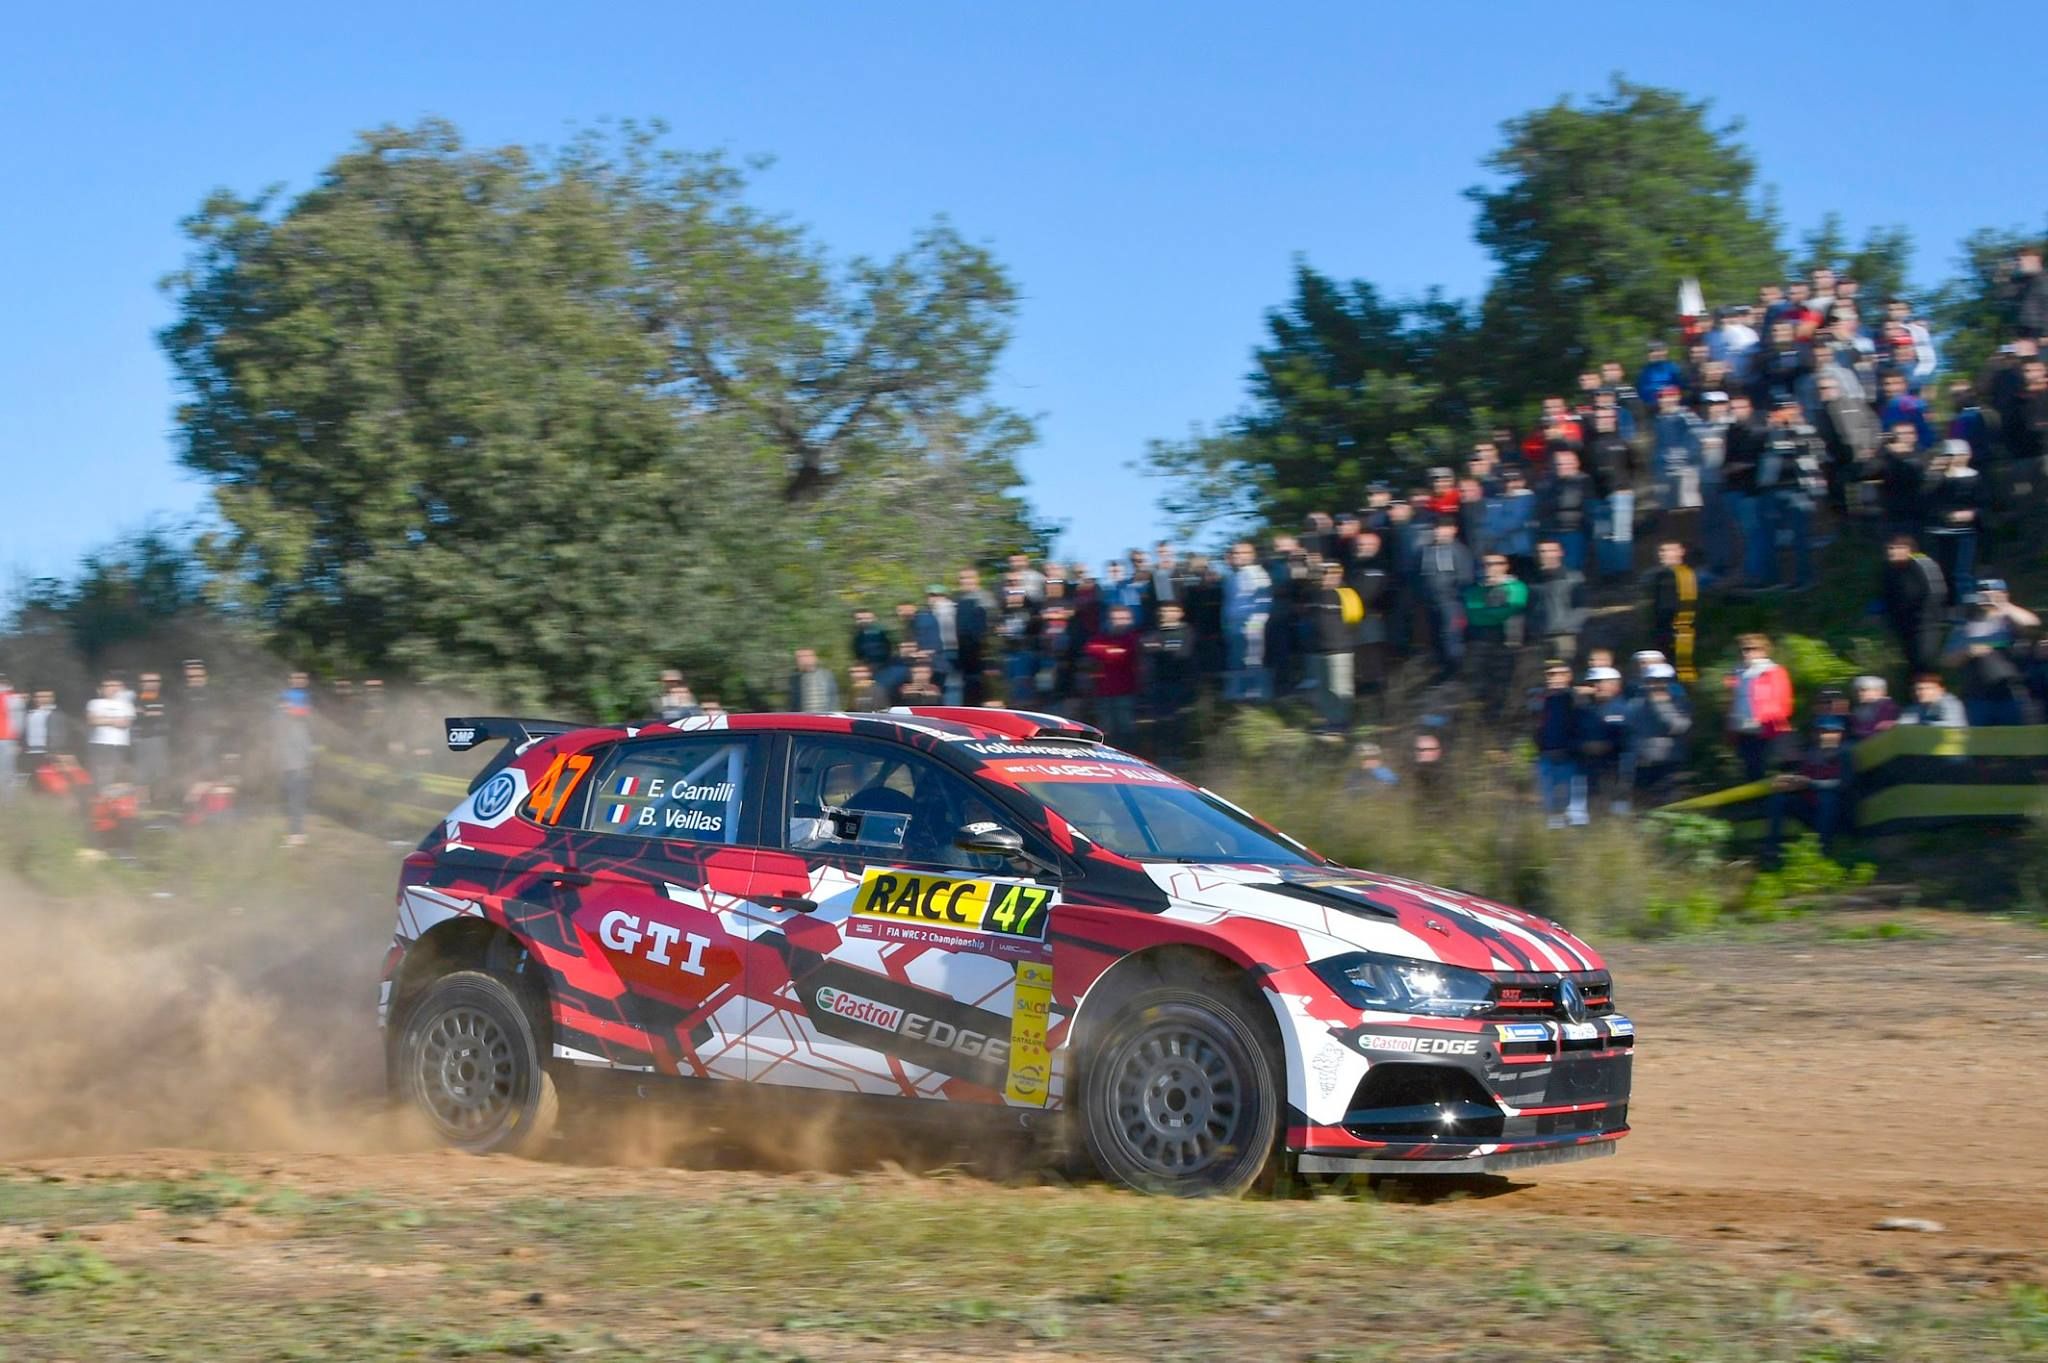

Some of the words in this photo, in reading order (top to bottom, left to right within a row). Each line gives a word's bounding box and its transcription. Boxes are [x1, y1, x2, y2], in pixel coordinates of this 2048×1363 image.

[449, 731, 475, 742] OMP
[528, 752, 594, 825] 47
[648, 779, 665, 798] E.
[671, 780, 735, 802] Camilli
[638, 806, 657, 826] B.
[665, 808, 722, 831] Veillas
[865, 874, 976, 922] RACC
[992, 885, 1046, 934] 47
[599, 910, 711, 977] GTI
[886, 926, 901, 937] FIA
[901, 928, 920, 940] WRC
[921, 931, 927, 941] 2
[928, 932, 985, 951] Championship
[833, 992, 899, 1030] Castrol
[899, 1012, 1010, 1065] EDGE
[1372, 1037, 1412, 1051] Castrol
[1415, 1038, 1479, 1055] EDGE
